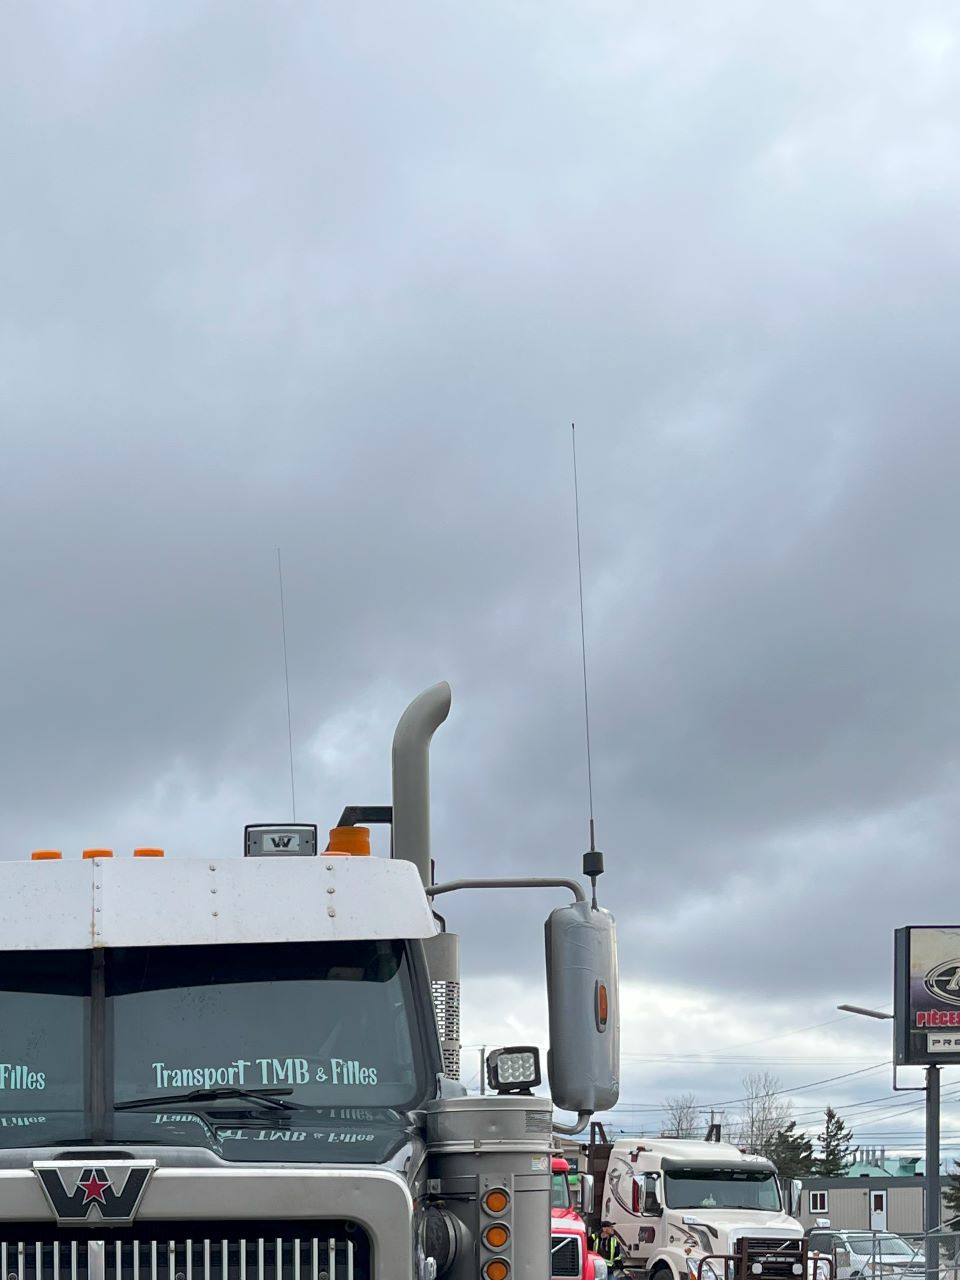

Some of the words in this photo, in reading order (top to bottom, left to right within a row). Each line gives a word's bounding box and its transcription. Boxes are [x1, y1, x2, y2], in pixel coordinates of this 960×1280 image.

[152, 1059, 251, 1090] Transport
[255, 1058, 310, 1085] TMB
[315, 1067, 328, 1082] &
[330, 1058, 378, 1086] Filles
[34, 1167, 155, 1221] W
